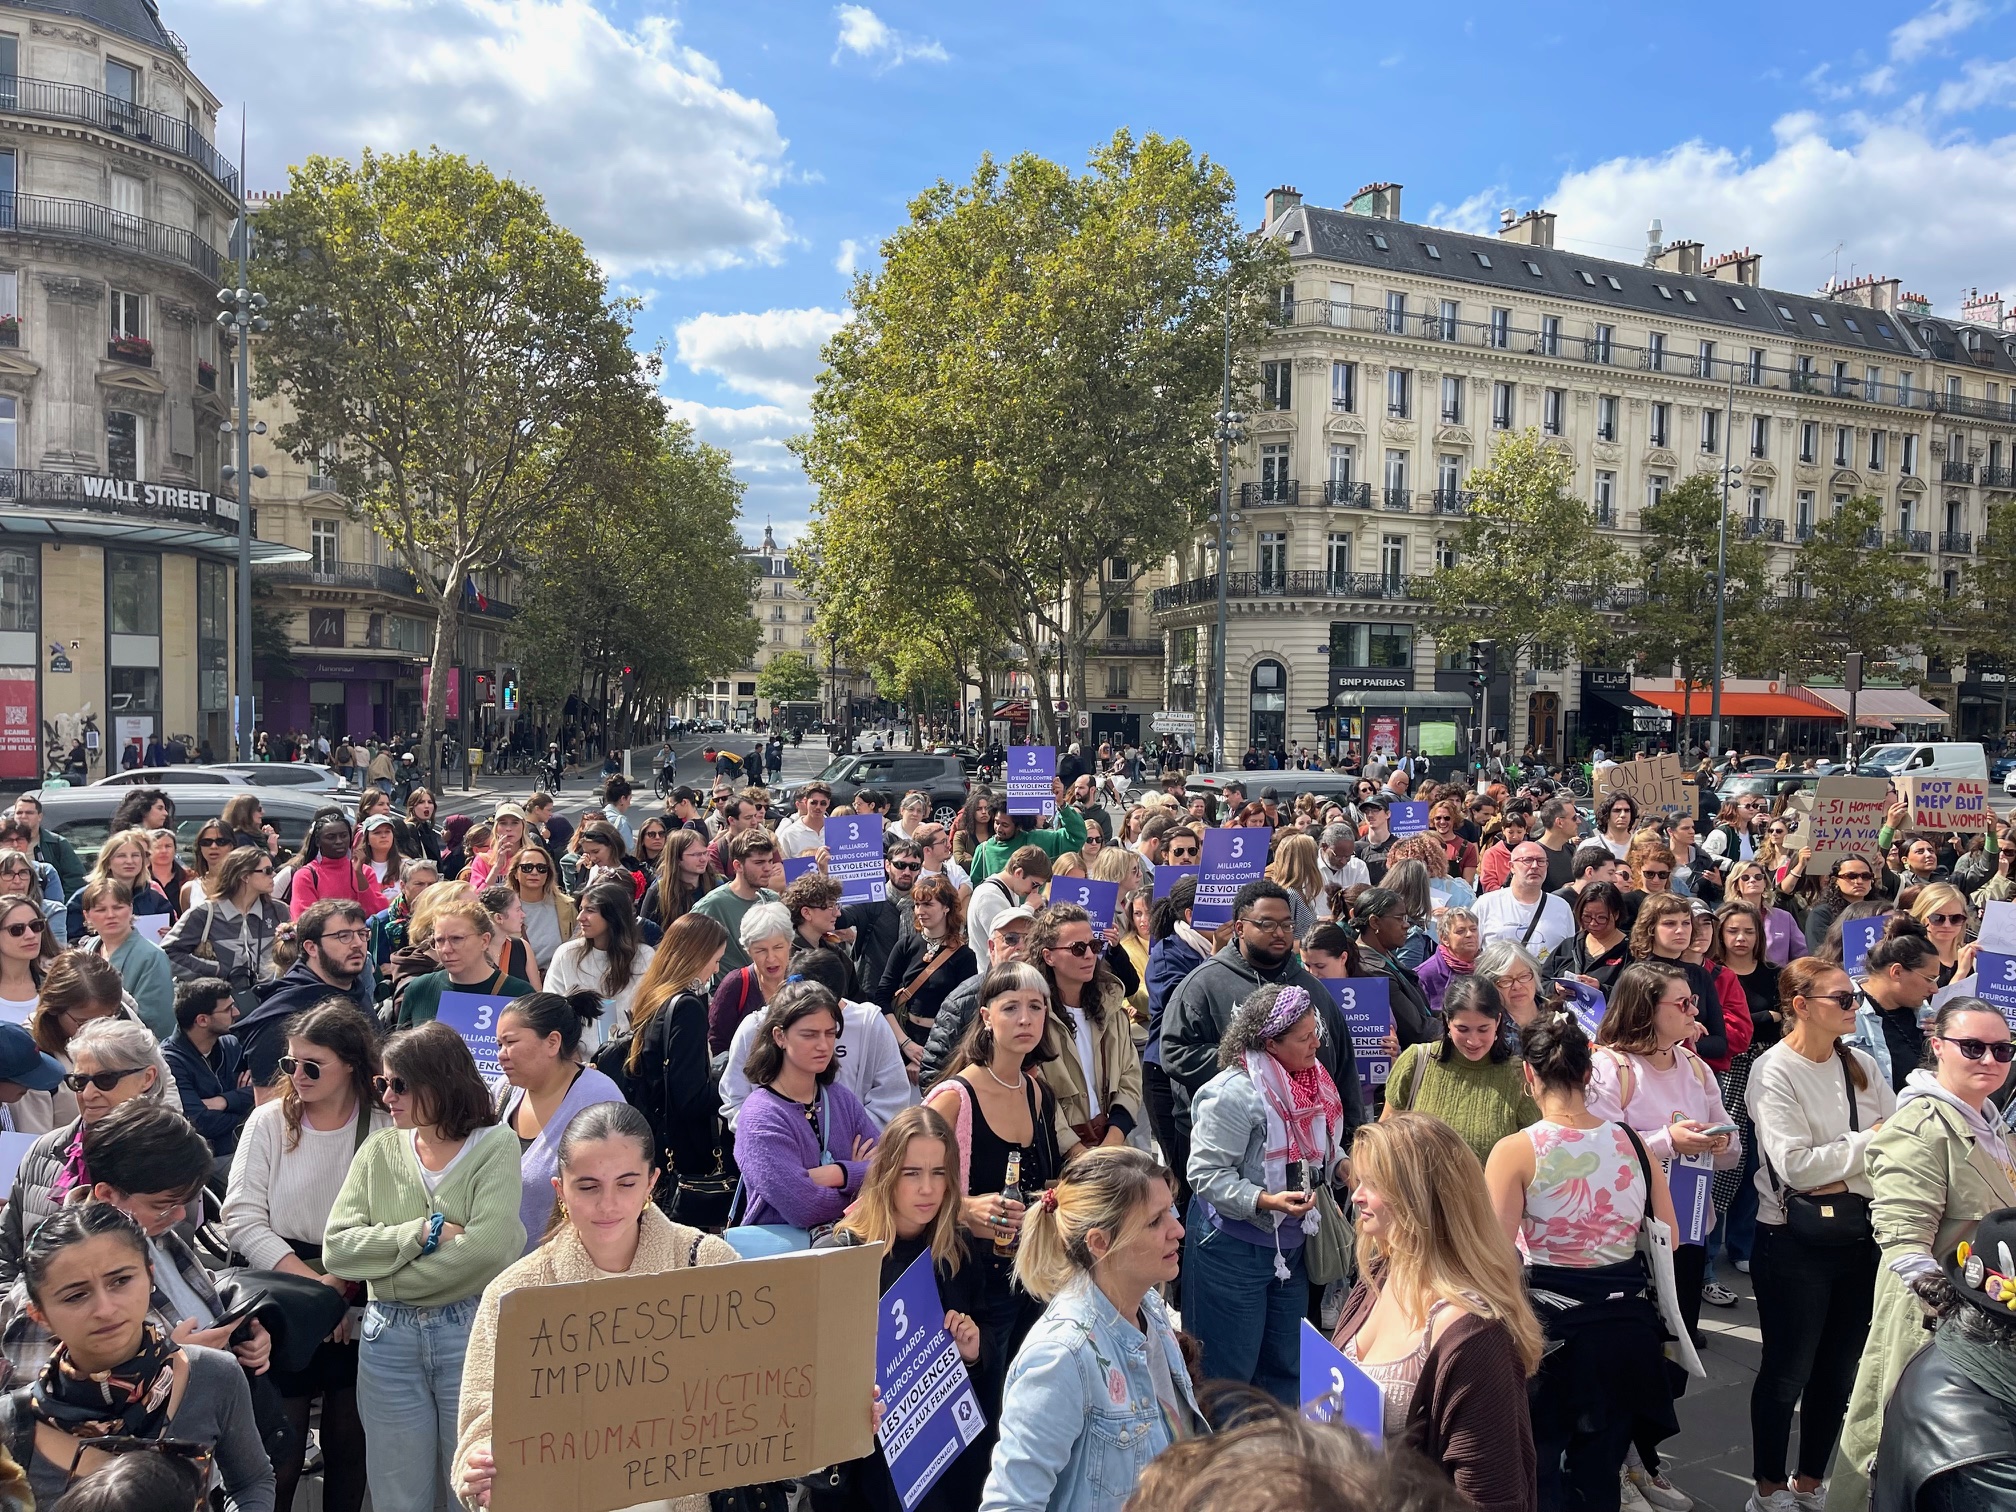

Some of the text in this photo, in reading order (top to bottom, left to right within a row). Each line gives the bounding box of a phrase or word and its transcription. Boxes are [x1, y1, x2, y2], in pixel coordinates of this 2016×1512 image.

[83, 476, 138, 502] WALL
[144, 484, 210, 510] STREET
[1339, 678, 1406, 687] BNP PARIBAS
[1592, 673, 1604, 684] LE
[1027, 752, 1036, 766] 3
[1610, 755, 1674, 788] ON TE
[1921, 782, 1983, 794] NOT ALL
[1849, 801, 1884, 813] HOMME
[1916, 795, 1984, 810] MEN BUT
[1406, 807, 1414, 818] 3
[1832, 816, 1843, 825] 10
[1846, 814, 1870, 825] ANS
[1916, 811, 1947, 828] ALL
[848, 823, 859, 840] 3
[839, 842, 868, 850] MILLIARDS
[1230, 837, 1244, 858] 3
[1815, 840, 1836, 851] ET
[843, 861, 882, 870] VIOLENCES
[1236, 872, 1261, 880] CONTRE
[1077, 887, 1090, 906] 3
[1864, 926, 1876, 948] 3
[2003, 960, 2016, 981] 3
[1341, 987, 1356, 1009] 3
[1980, 992, 2008, 1002] D'EUROS
[474, 1005, 493, 1030] 3
[530, 1285, 776, 1358] AGRESSEURS
[890, 1299, 909, 1340] 3
[886, 1326, 926, 1378] MILLIARDS
[913, 1329, 946, 1371] CONTRE
[530, 1346, 670, 1398] IMPUNIS
[882, 1348, 955, 1439] LES VIOLENCES
[888, 1368, 962, 1459] FAITES AUX FEMMES
[508, 1404, 758, 1465] TRAUMATISMES
